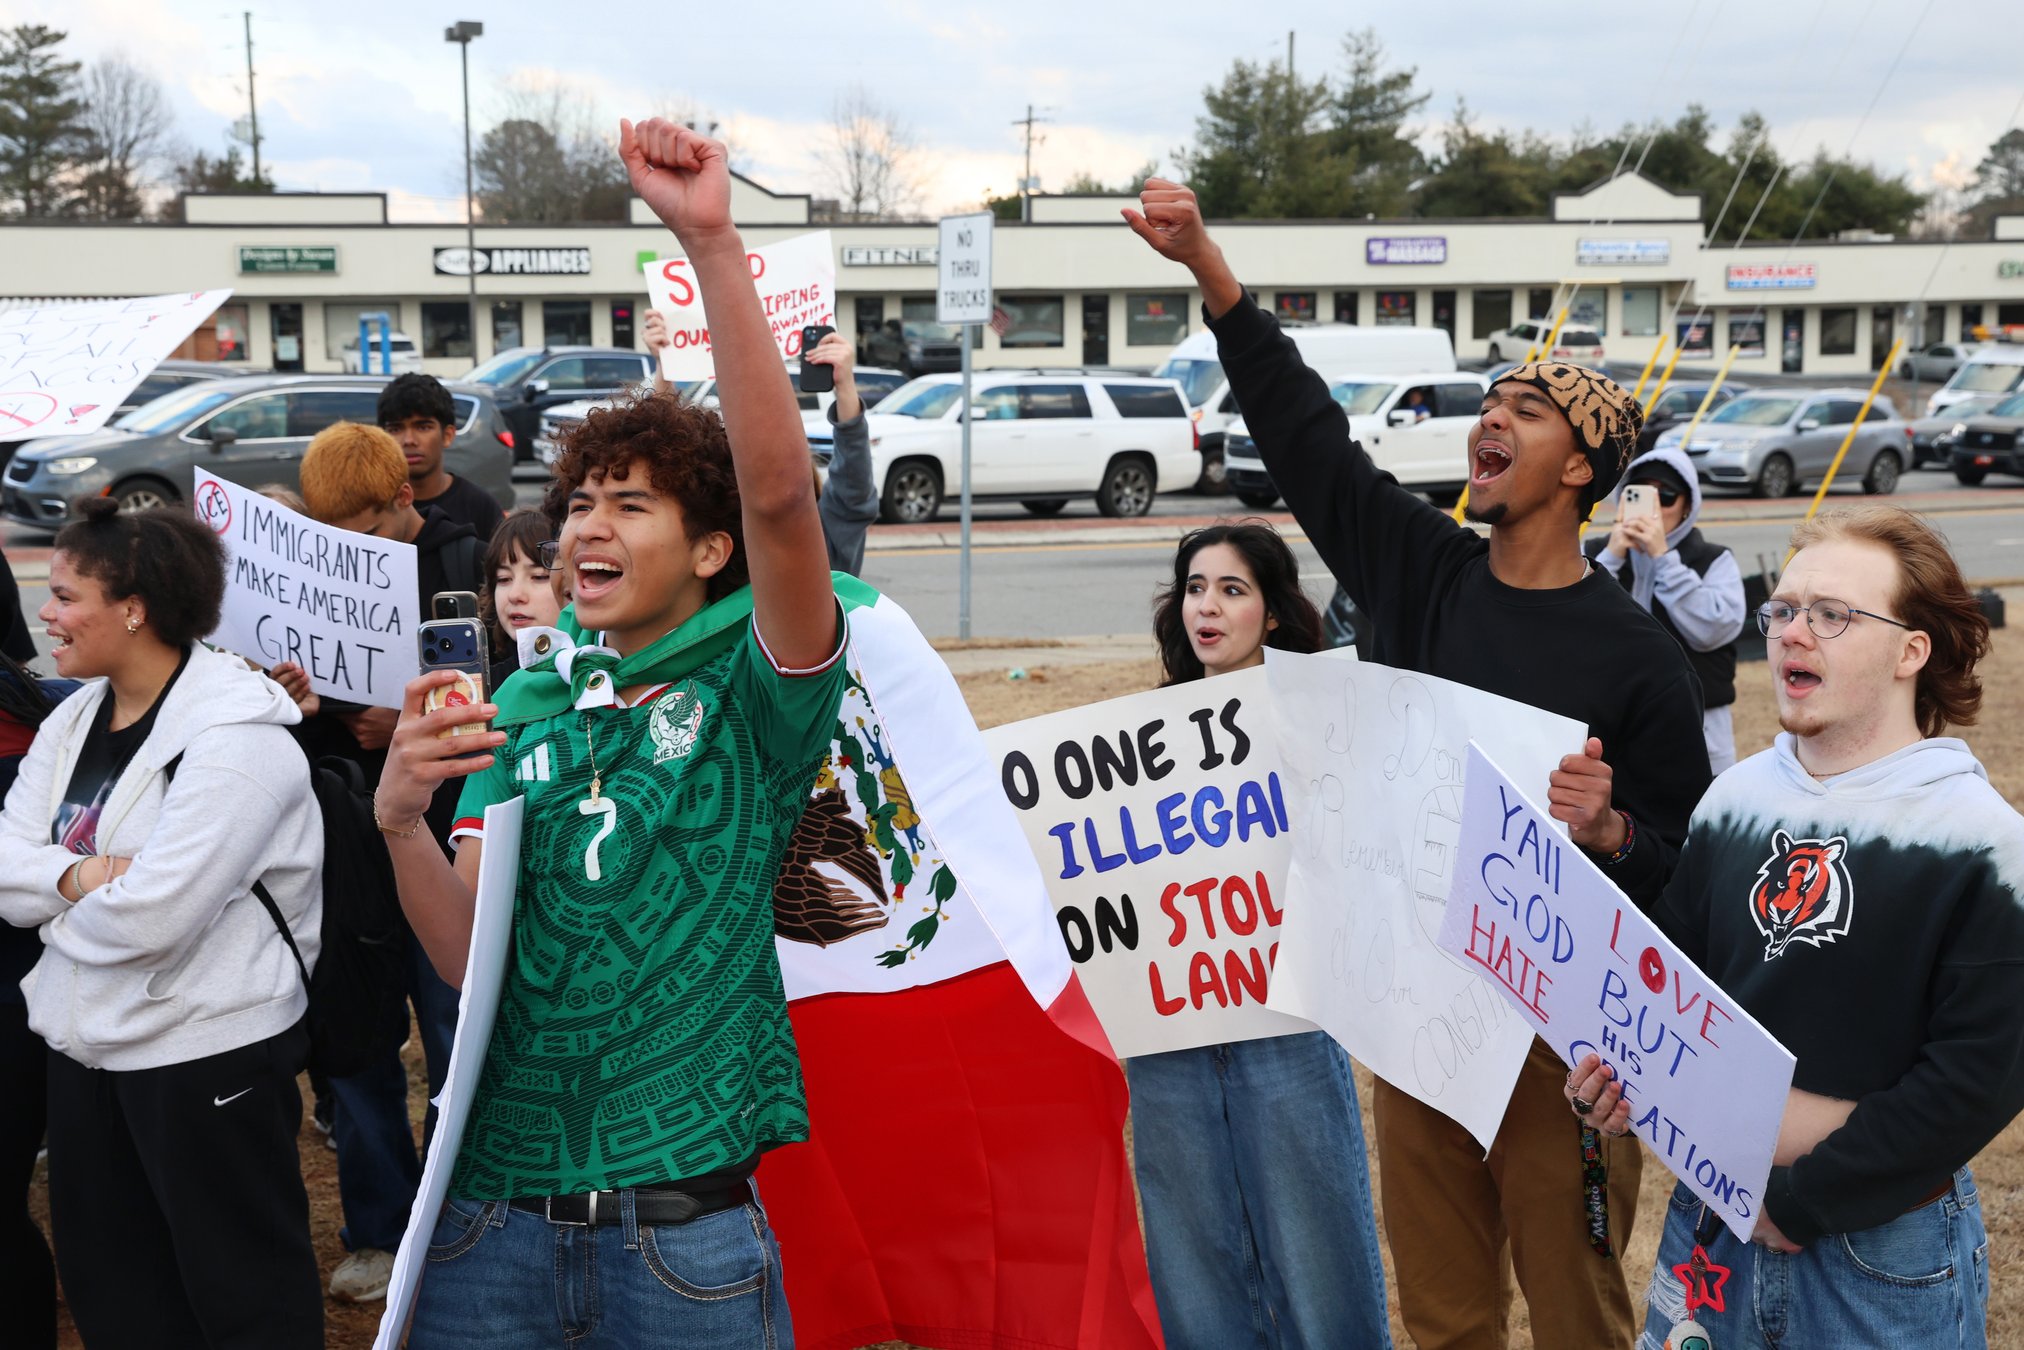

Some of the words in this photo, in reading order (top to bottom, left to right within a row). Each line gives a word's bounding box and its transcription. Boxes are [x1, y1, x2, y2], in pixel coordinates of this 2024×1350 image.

[491, 249, 591, 274] APPLIANCES
[951, 260, 980, 278] THRU
[956, 230, 974, 248] NO
[1728, 265, 1816, 278] INSURANCE
[762, 284, 820, 317] IPPING
[944, 289, 987, 309] TRUCKS
[198, 490, 229, 521] ICE
[242, 498, 391, 590] IMMIGRANTS
[235, 556, 291, 605] MAKE
[297, 582, 401, 636] AMERICA
[255, 614, 385, 694] GREAT
[1002, 750, 1040, 810] O
[1054, 718, 1176, 800] ONE
[1188, 697, 1251, 771] IS
[579, 797, 617, 881] 7
[1056, 893, 1140, 964] ON
[1160, 870, 1284, 948] STOL
[1149, 940, 1280, 1017] LAN
[1468, 903, 1555, 1020] HATE
[1601, 1024, 1642, 1076] HIS
[1481, 852, 1575, 965] GOD
[1598, 968, 1699, 1078] BUT
[1609, 908, 1735, 1049] LOVE
[1590, 1185, 1605, 1238] Mexico
